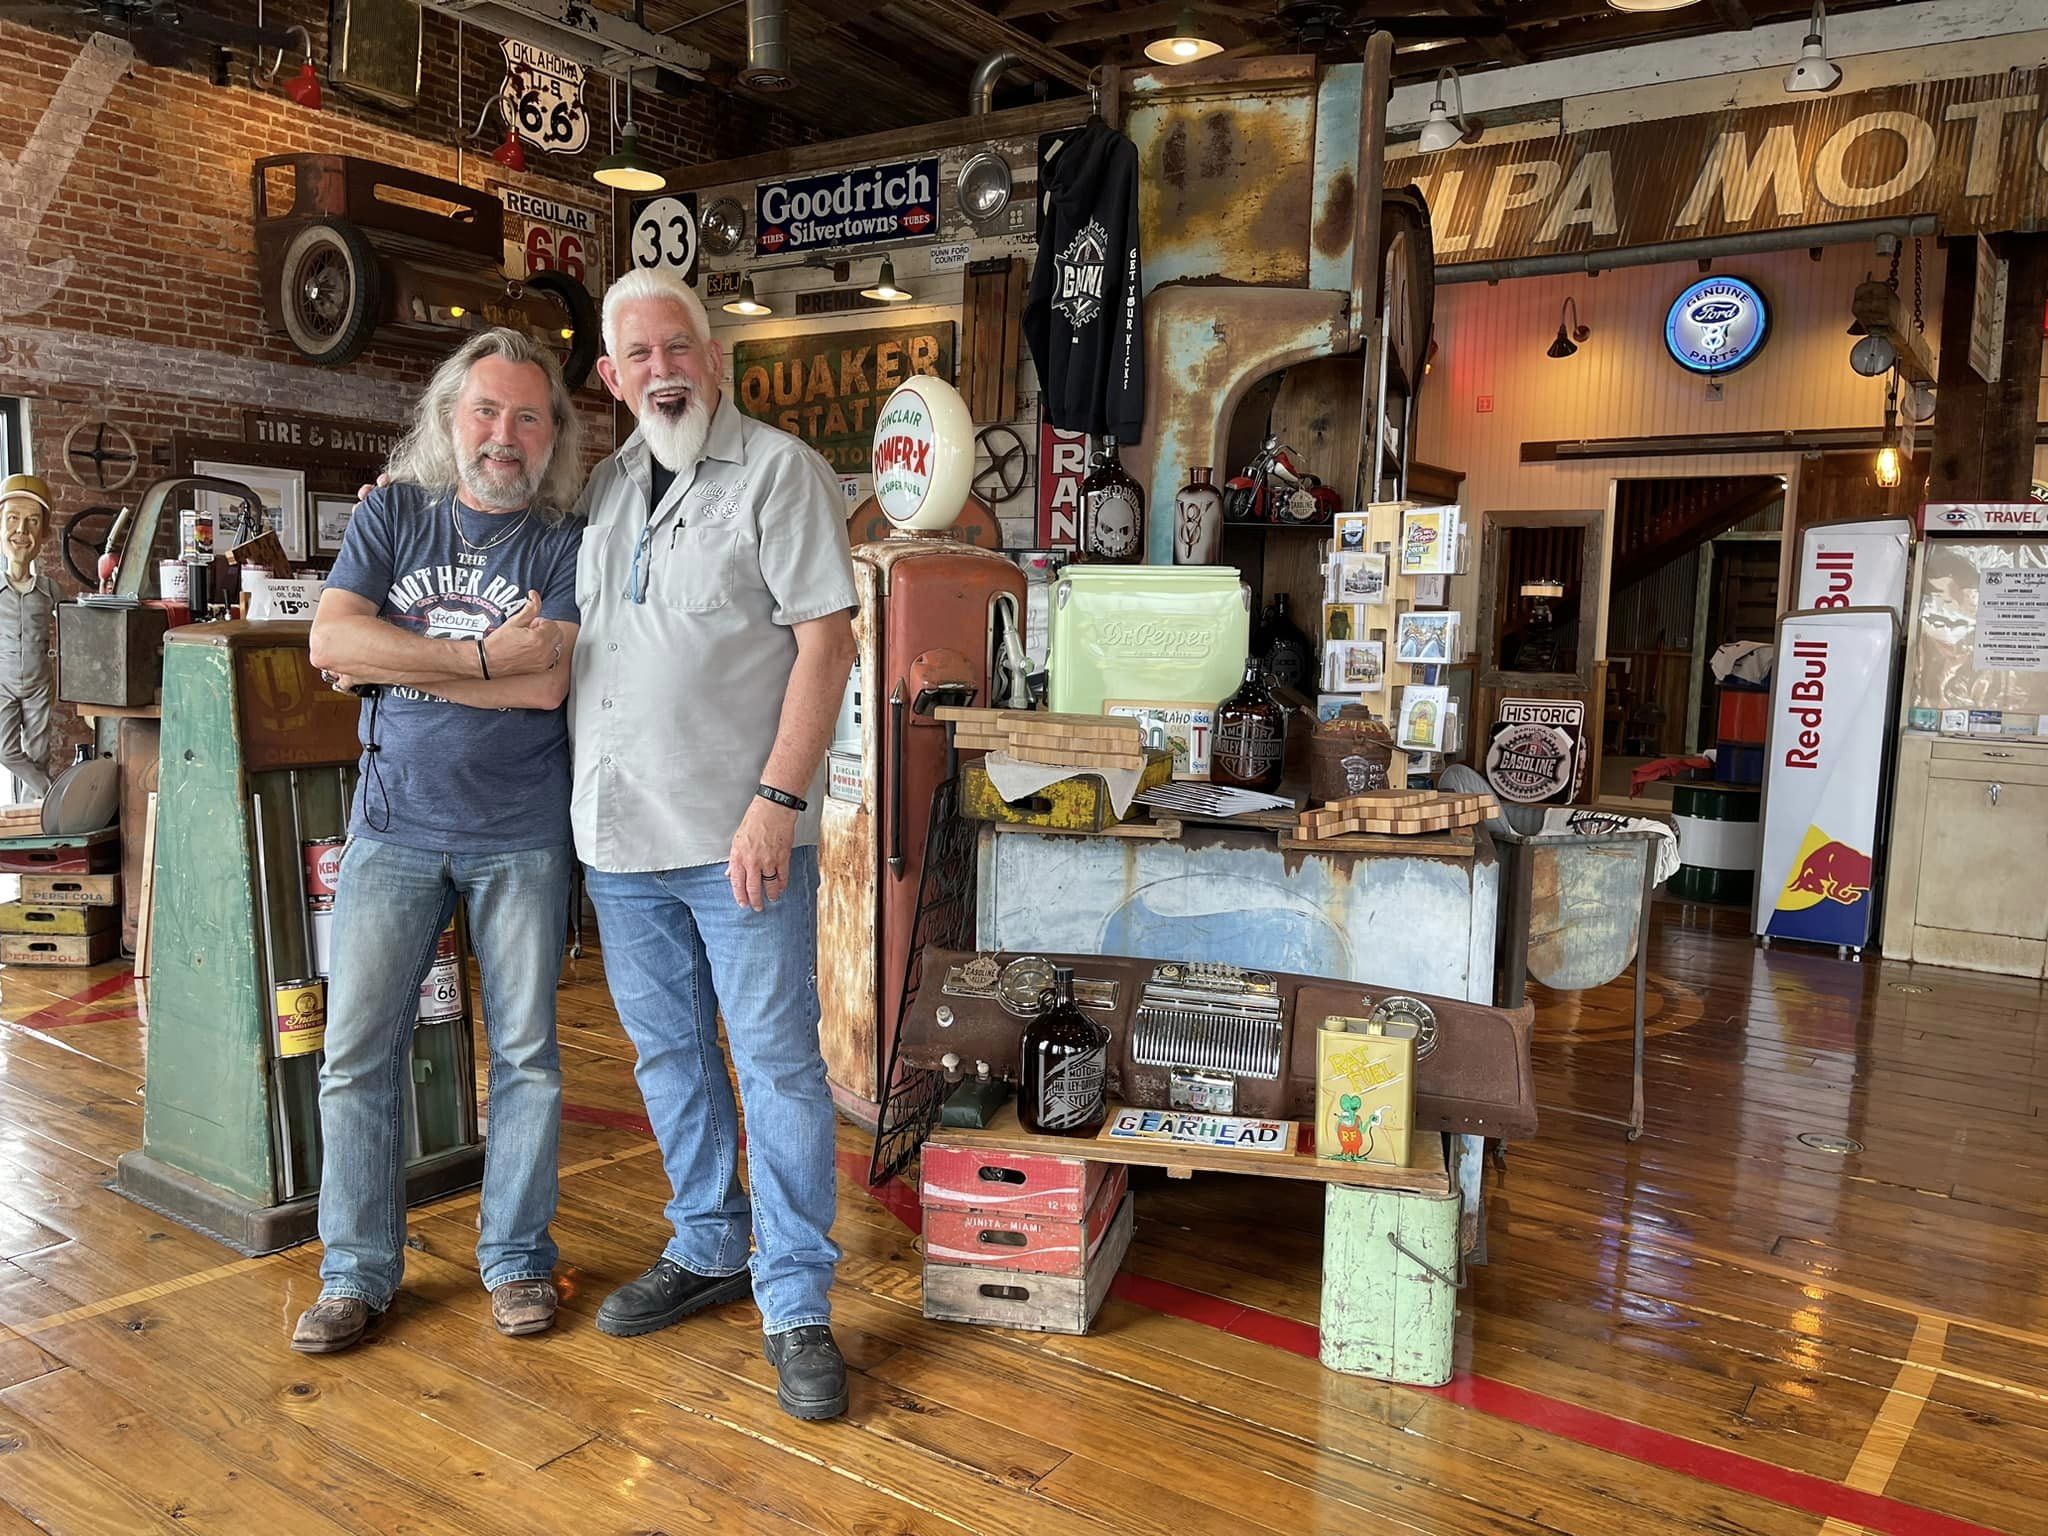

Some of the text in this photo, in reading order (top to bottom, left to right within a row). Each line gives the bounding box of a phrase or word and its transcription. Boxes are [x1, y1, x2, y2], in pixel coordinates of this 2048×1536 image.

[513, 42, 579, 80] OKLAHOMA
[518, 91, 573, 142] 66
[762, 166, 932, 224] Goodrich
[1412, 150, 1618, 256] LPA
[507, 192, 588, 230] REGULAR
[903, 213, 930, 226] TUBES
[639, 215, 690, 268] 33
[761, 233, 784, 245] TIRES
[789, 214, 898, 246] Silvertowns
[934, 253, 965, 264] COUNTRY
[1686, 286, 1749, 308] GENUINE
[1694, 302, 1740, 321] Ford
[1690, 347, 1740, 363] PARTS
[741, 335, 940, 414] QUAKER
[256, 420, 302, 444] TIRE
[309, 426, 324, 447] &
[881, 409, 922, 433] SINCLAIR
[1946, 511, 2041, 523] DX TRAVEL
[456, 552, 488, 567] THE
[388, 565, 529, 619] MOTHER ROA
[1815, 552, 1854, 608] Bull
[435, 613, 480, 628] ROUTE
[1135, 621, 1211, 653] Pepper
[1506, 707, 1576, 723] HISTORIC
[1785, 641, 1828, 769] Bull Red
[1500, 751, 1557, 778] GASOLINE
[1510, 772, 1538, 784] ALLEY
[72, 893, 103, 901] COLA
[438, 983, 457, 1000] 66
[1328, 1046, 1369, 1076] RAT
[1349, 1063, 1397, 1093] FUEL
[1118, 1116, 1279, 1144] GEARHEAD
[1341, 1130, 1357, 1142] RF
[1009, 1222, 1042, 1233] MIAMI
